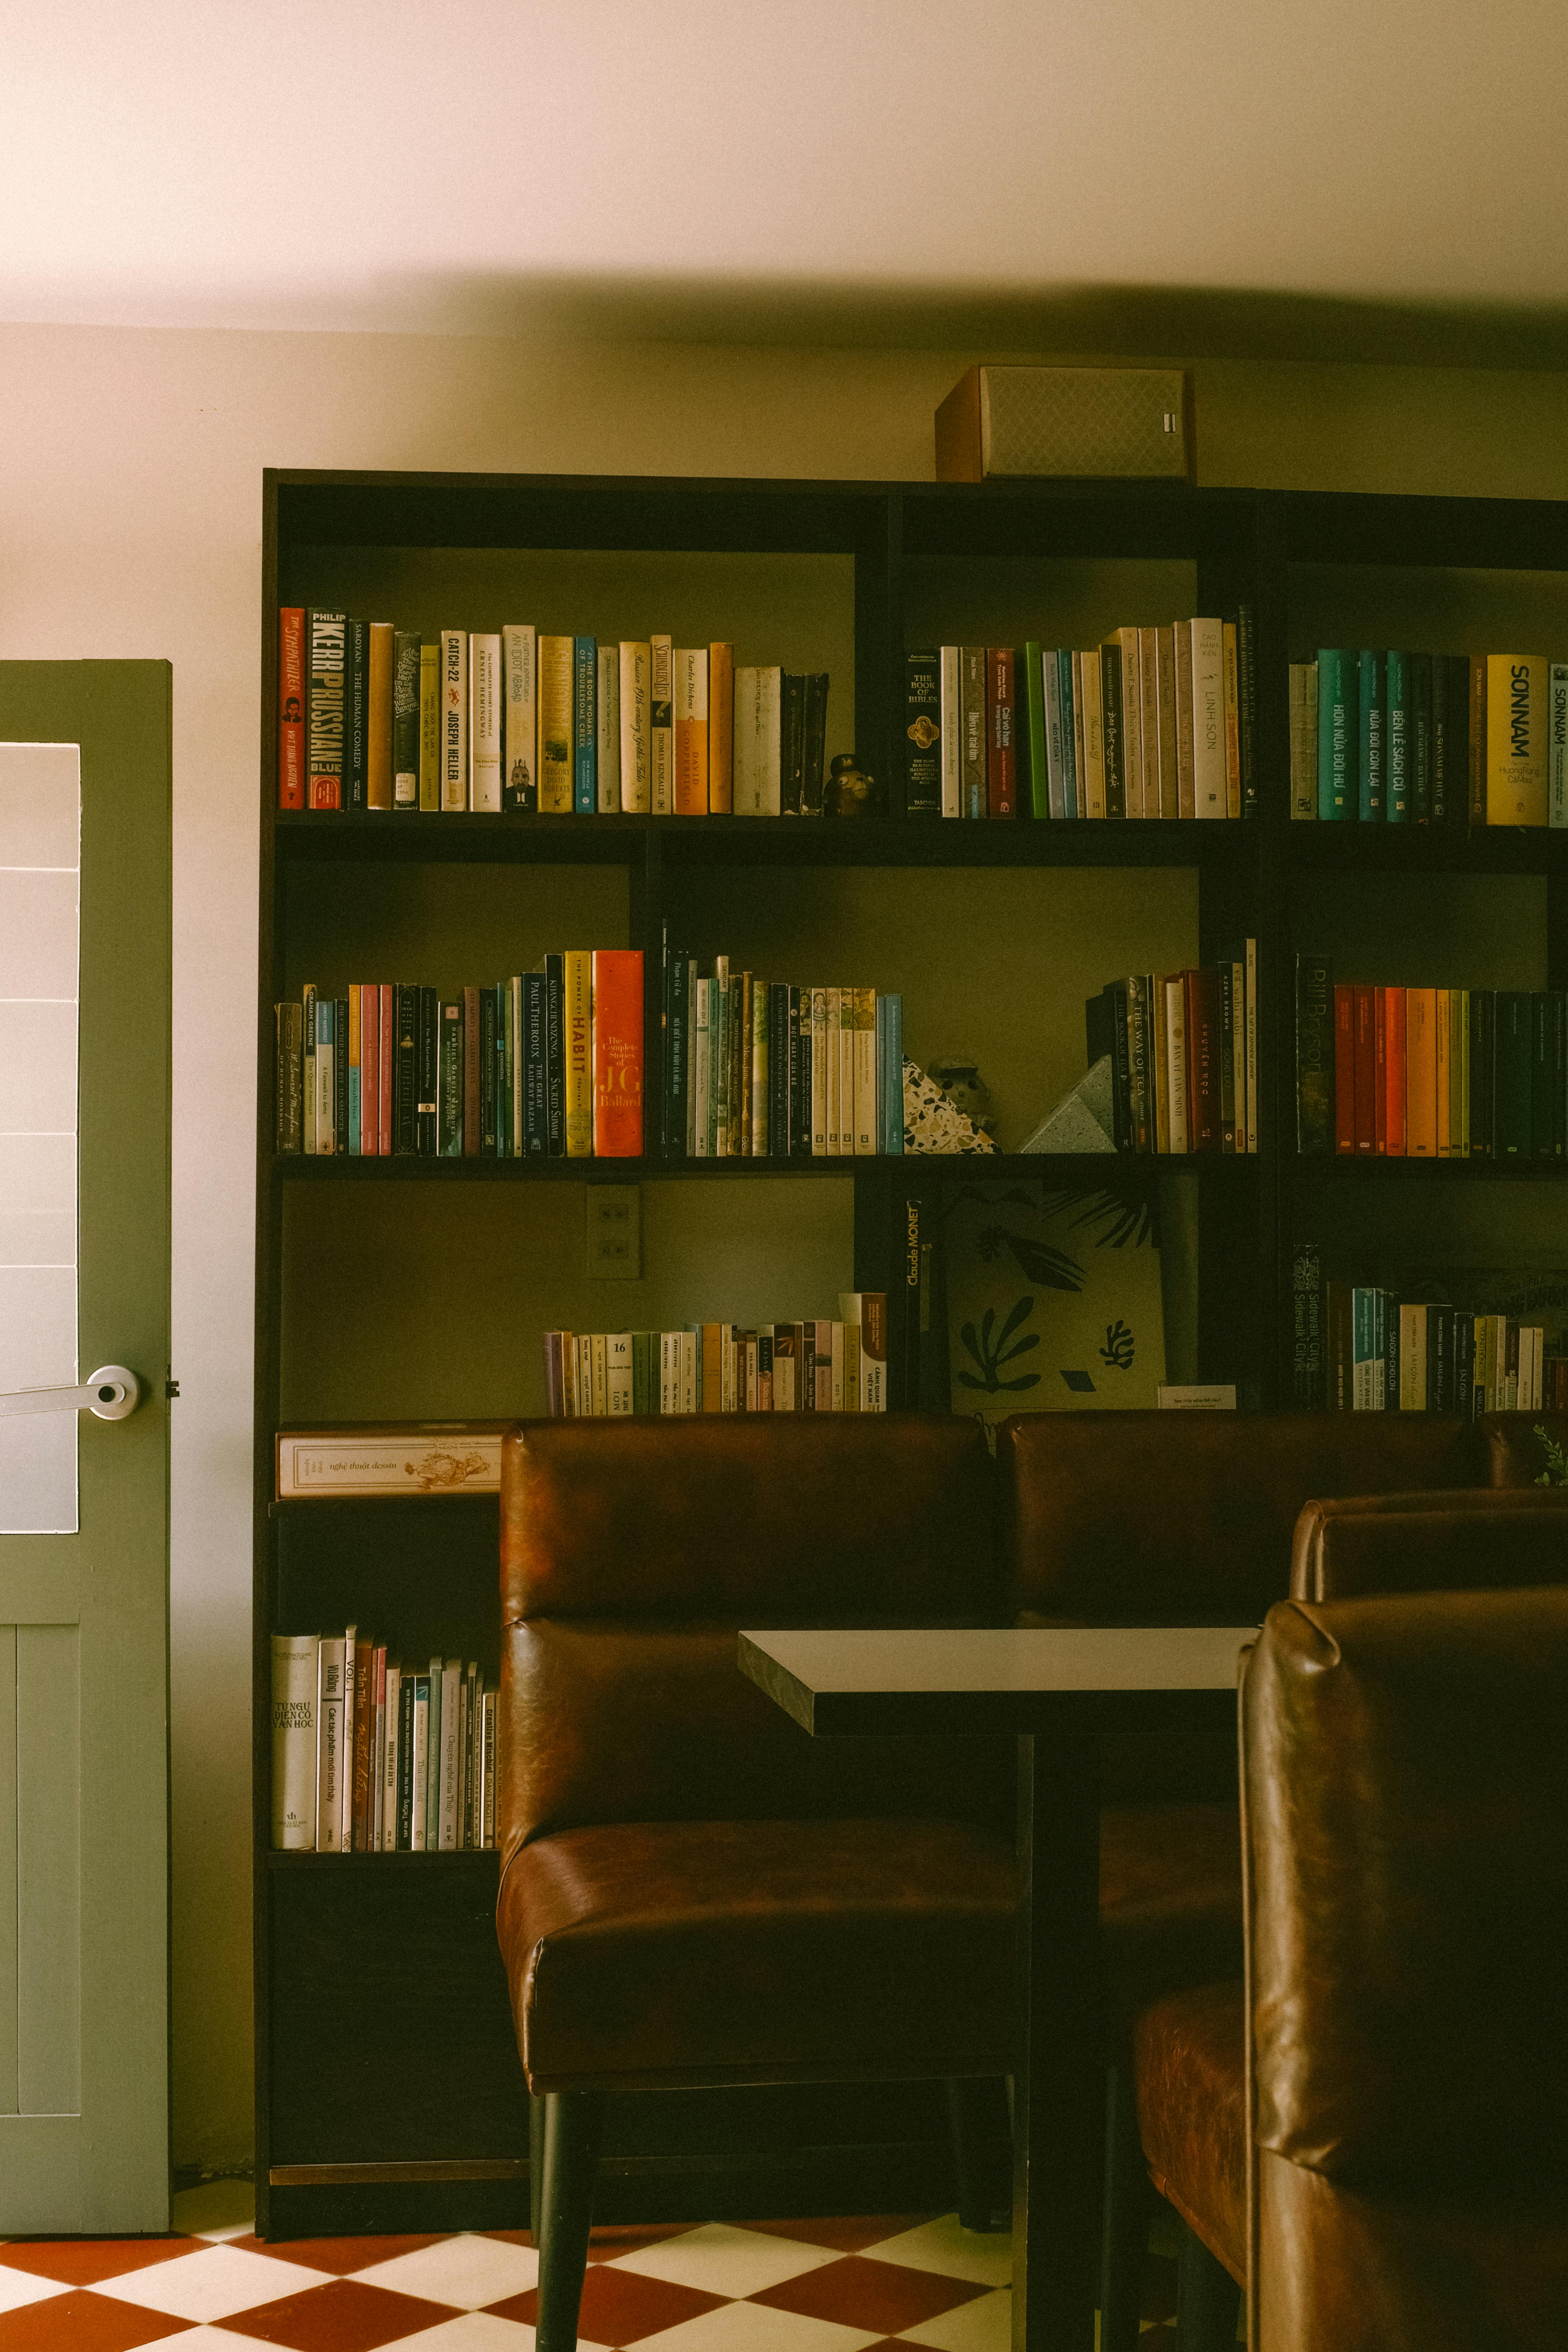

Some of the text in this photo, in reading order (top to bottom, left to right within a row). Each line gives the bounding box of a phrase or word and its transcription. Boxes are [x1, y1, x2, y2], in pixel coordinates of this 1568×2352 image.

[313, 613, 346, 621] PHILIP
[285, 616, 300, 692] THE SYMPATHIZER
[312, 623, 345, 670] KERR
[579, 650, 585, 660] OF
[511, 633, 522, 702] AN IDIOT ABROAD
[635, 652, 644, 683] Russian
[311, 672, 344, 762] PRUSSIAN
[447, 638, 459, 780] CATCH-22 JOSEPH HELLER
[1206, 692, 1216, 749] LINH SƠN
[1333, 705, 1345, 726] HƠN
[1393, 711, 1405, 730] BÊN
[286, 730, 298, 788] VIET THANH NGUYEN
[353, 730, 361, 769] COMEDY
[632, 736, 645, 760] Gothic
[1393, 747, 1405, 774] SÁCH
[311, 763, 342, 772] BLUE
[636, 762, 645, 782] Tales
[1368, 772, 1379, 786] LẠI
[531, 982, 540, 1058] PAUL THEROUX
[576, 1006, 581, 1015] OF
[573, 1017, 585, 1073] HABIT
[603, 1043, 638, 1053] Complete
[280, 1056, 283, 1065] OF
[1136, 1058, 1143, 1072] OF
[285, 1053, 299, 1133] W. Somerset Maugham
[550, 1078, 560, 1108] SACRED
[601, 1095, 640, 1106] Ballard
[550, 1110, 561, 1139] SUMMIT
[907, 1208, 918, 1286] Claude MONET
[1295, 1294, 1307, 1363] Sidewalk City
[1309, 1294, 1321, 1362] Sidewalk City
